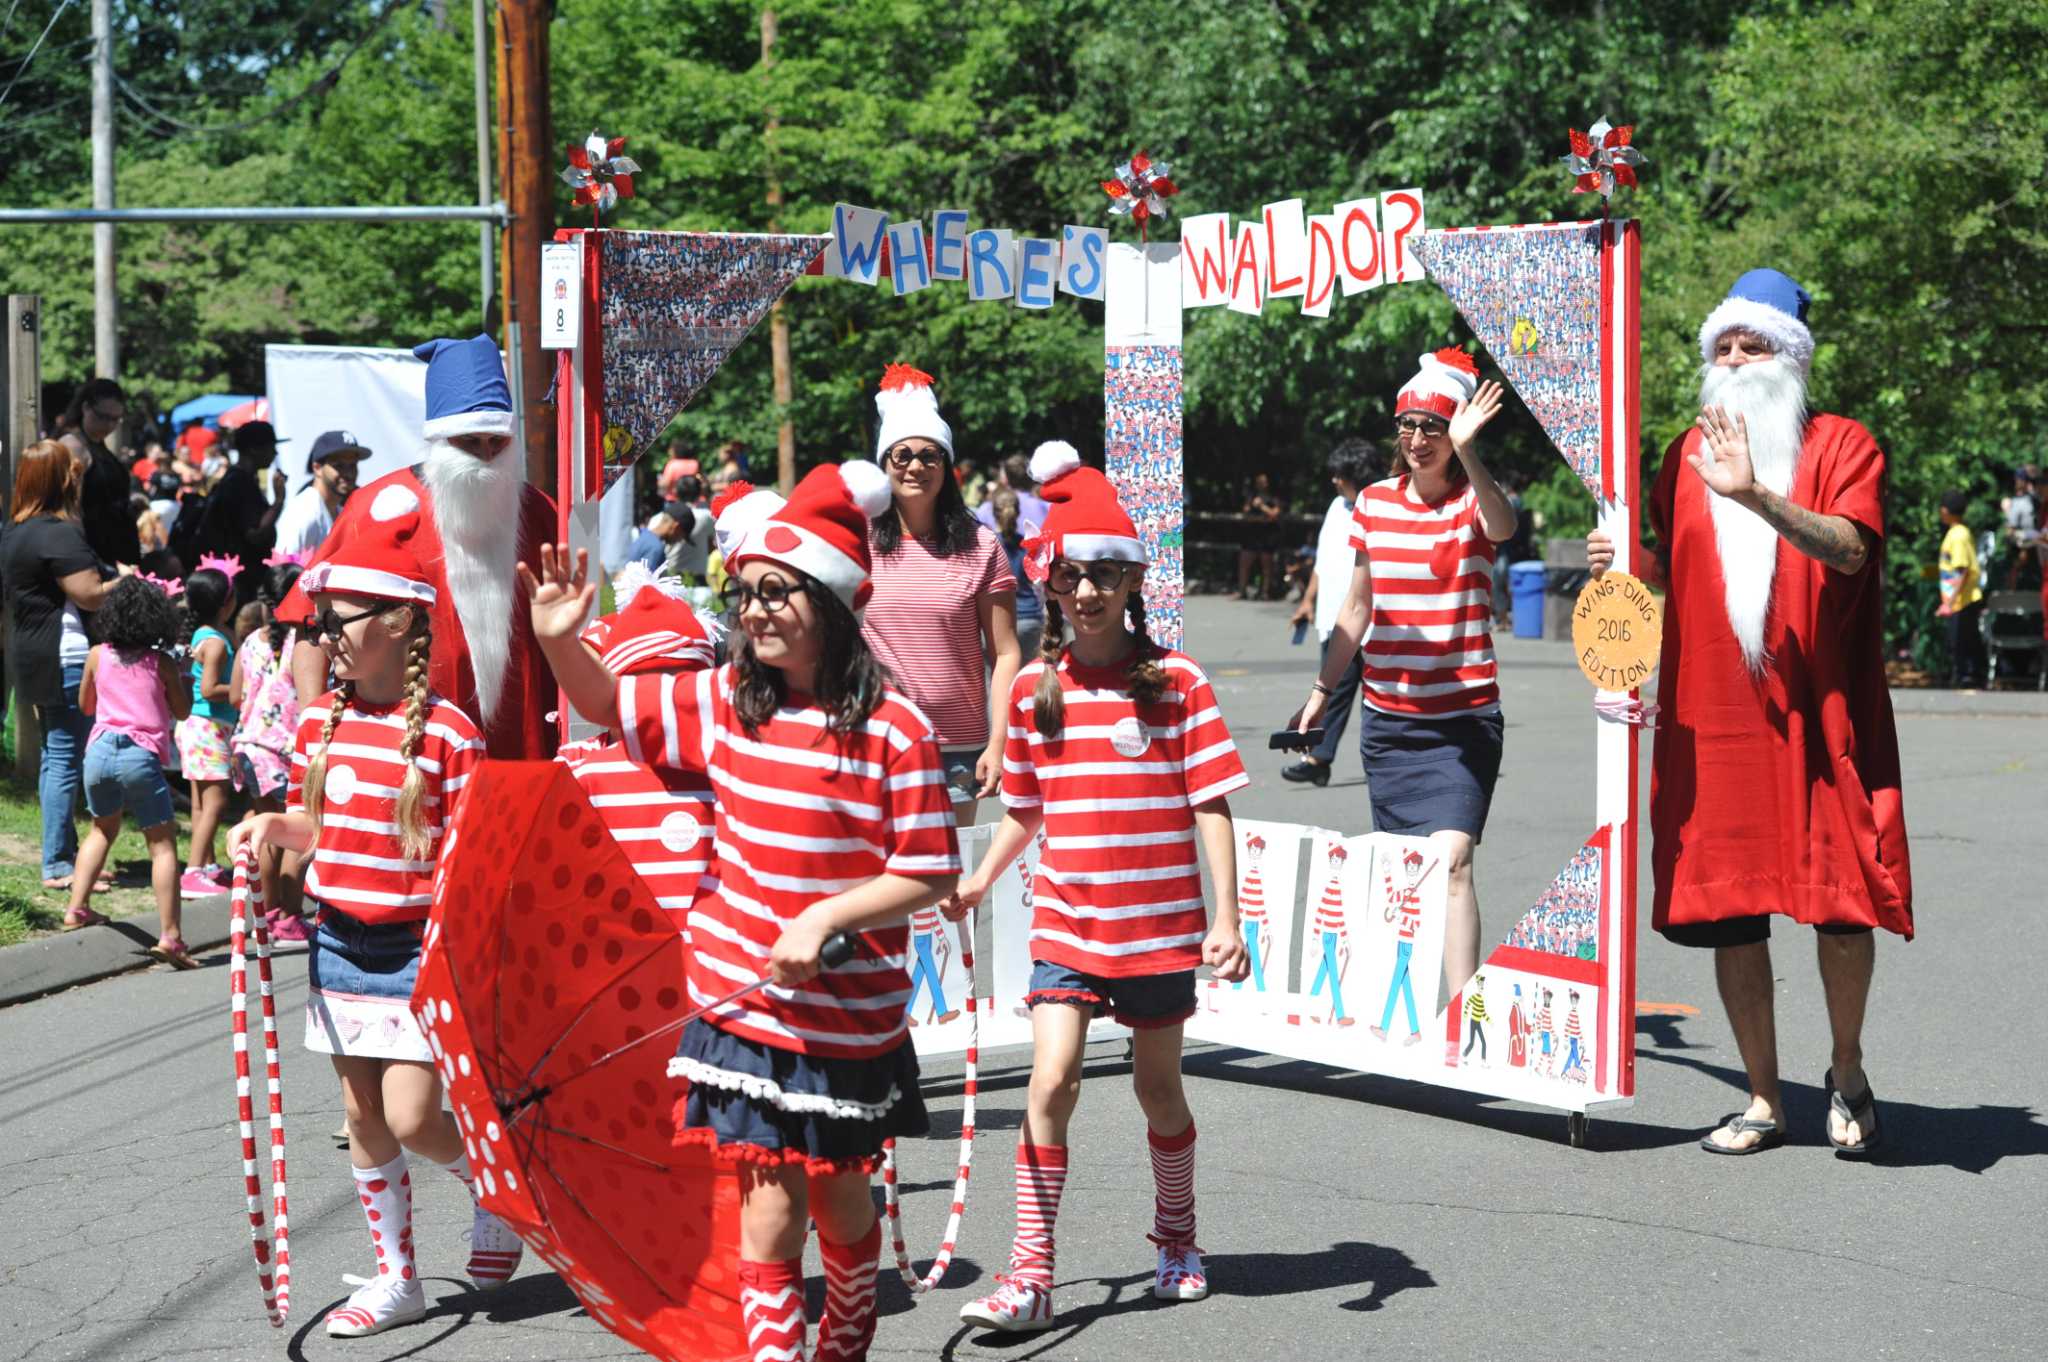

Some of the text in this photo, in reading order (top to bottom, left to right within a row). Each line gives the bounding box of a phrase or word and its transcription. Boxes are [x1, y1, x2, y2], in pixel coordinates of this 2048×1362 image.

[837, 192, 1423, 310] WHERE'S WALDO?
[556, 308, 564, 327] 8
[1598, 618, 1631, 641] 2016
[1582, 647, 1648, 687] EDITION
